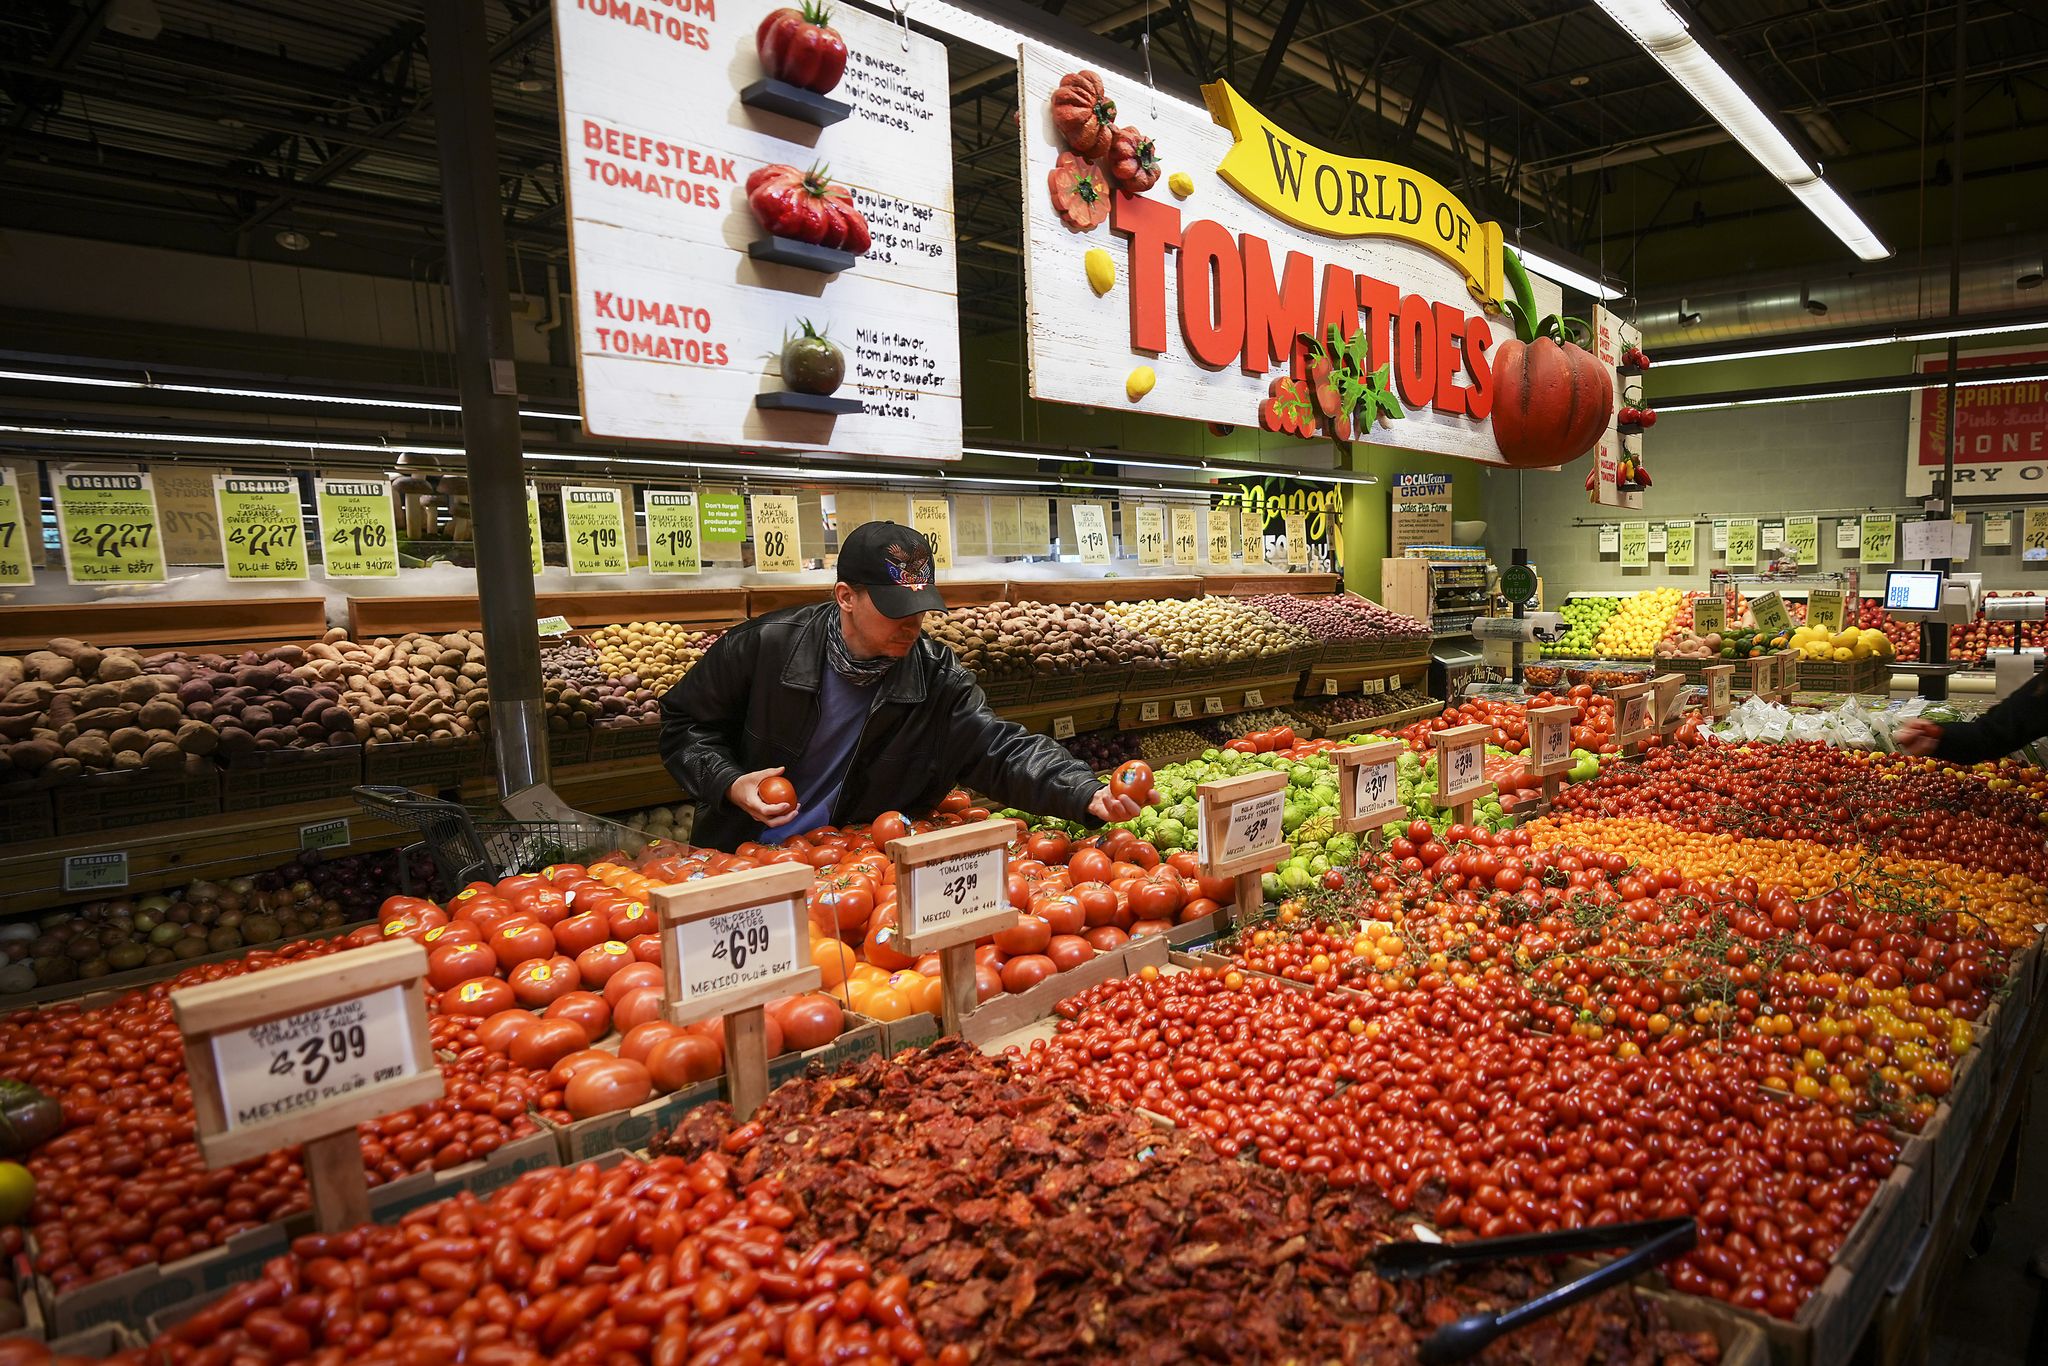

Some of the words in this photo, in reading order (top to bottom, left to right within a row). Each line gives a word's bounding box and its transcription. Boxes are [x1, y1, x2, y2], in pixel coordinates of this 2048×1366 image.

[847, 51, 861, 62] re
[859, 107, 914, 133] tomatoes.
[895, 101, 933, 120] cultivar
[583, 120, 737, 183] BEEFSTEAK
[585, 158, 720, 209] TOMATOES
[1261, 125, 1422, 225] WORLD
[1435, 201, 1471, 255] OF
[894, 199, 909, 213] for
[912, 202, 933, 221] beef
[903, 222, 920, 233] and
[901, 238, 913, 249] on
[916, 237, 943, 257] large
[595, 291, 711, 333] KUMATO
[1110, 189, 1493, 420] TOMATOES
[595, 327, 729, 366] TOMATOES
[857, 328, 877, 344] Mild
[882, 332, 891, 346] in
[856, 345, 881, 362] from
[884, 350, 919, 366] almost
[923, 358, 935, 369] no
[856, 364, 887, 380] flavor
[890, 369, 901, 382] to
[904, 372, 945, 387] sweeter
[885, 385, 919, 401] typical
[1955, 384, 2041, 408] SPARTAN
[863, 403, 915, 420] omatoes.
[1955, 408, 1999, 428] Pink
[72, 477, 137, 489] ORGANIC
[1400, 473, 1427, 486] LOCAL
[1427, 473, 1446, 484] Texas
[2019, 466, 2048, 480] O
[230, 481, 285, 492] ORGANIC
[329, 484, 380, 495] ORGANIC
[1401, 485, 1445, 497] GROWN
[573, 492, 612, 502] ORGANIC
[653, 495, 689, 505] ORGANIC
[68, 508, 104, 516] SWEET
[110, 508, 150, 516] POTATO
[338, 505, 371, 513] ORGANIC
[1400, 502, 1417, 513] Sides
[1418, 502, 1430, 513] Pea
[1431, 502, 1447, 513] Farm
[227, 516, 257, 524] SWEET
[72, 523, 153, 557] $227
[229, 524, 297, 557] $227
[332, 524, 387, 557] $168
[577, 528, 617, 556] $199
[656, 529, 693, 556] $198
[1081, 532, 1103, 551] $159
[1140, 532, 1161, 552] $148
[1623, 542, 1645, 555] $277
[1667, 539, 1691, 556] $347
[1729, 539, 1754, 555] $348
[1814, 611, 1834, 623] $168
[1453, 671, 1472, 697] Sides
[1472, 664, 1486, 680] Pea
[1485, 666, 1502, 685] Farm
[1364, 774, 1387, 801] $397
[306, 822, 342, 834] ORGANIC
[73, 855, 120, 865] ORGANIC
[939, 860, 979, 876] TOMATOES
[943, 873, 978, 904] $399
[709, 908, 762, 928] SUN-DRIED
[714, 916, 764, 935] TOMATOES
[922, 910, 951, 924] MEXICO
[712, 925, 769, 969] $699
[691, 974, 739, 995] MEXICO
[741, 969, 768, 983] PLU#
[249, 1024, 281, 1037] SAN
[287, 1002, 363, 1028] MARZANO
[256, 1024, 321, 1049] TOMATO
[328, 1011, 368, 1030] BULK
[269, 1025, 366, 1084] $399
[238, 1089, 319, 1124] MEXICO
